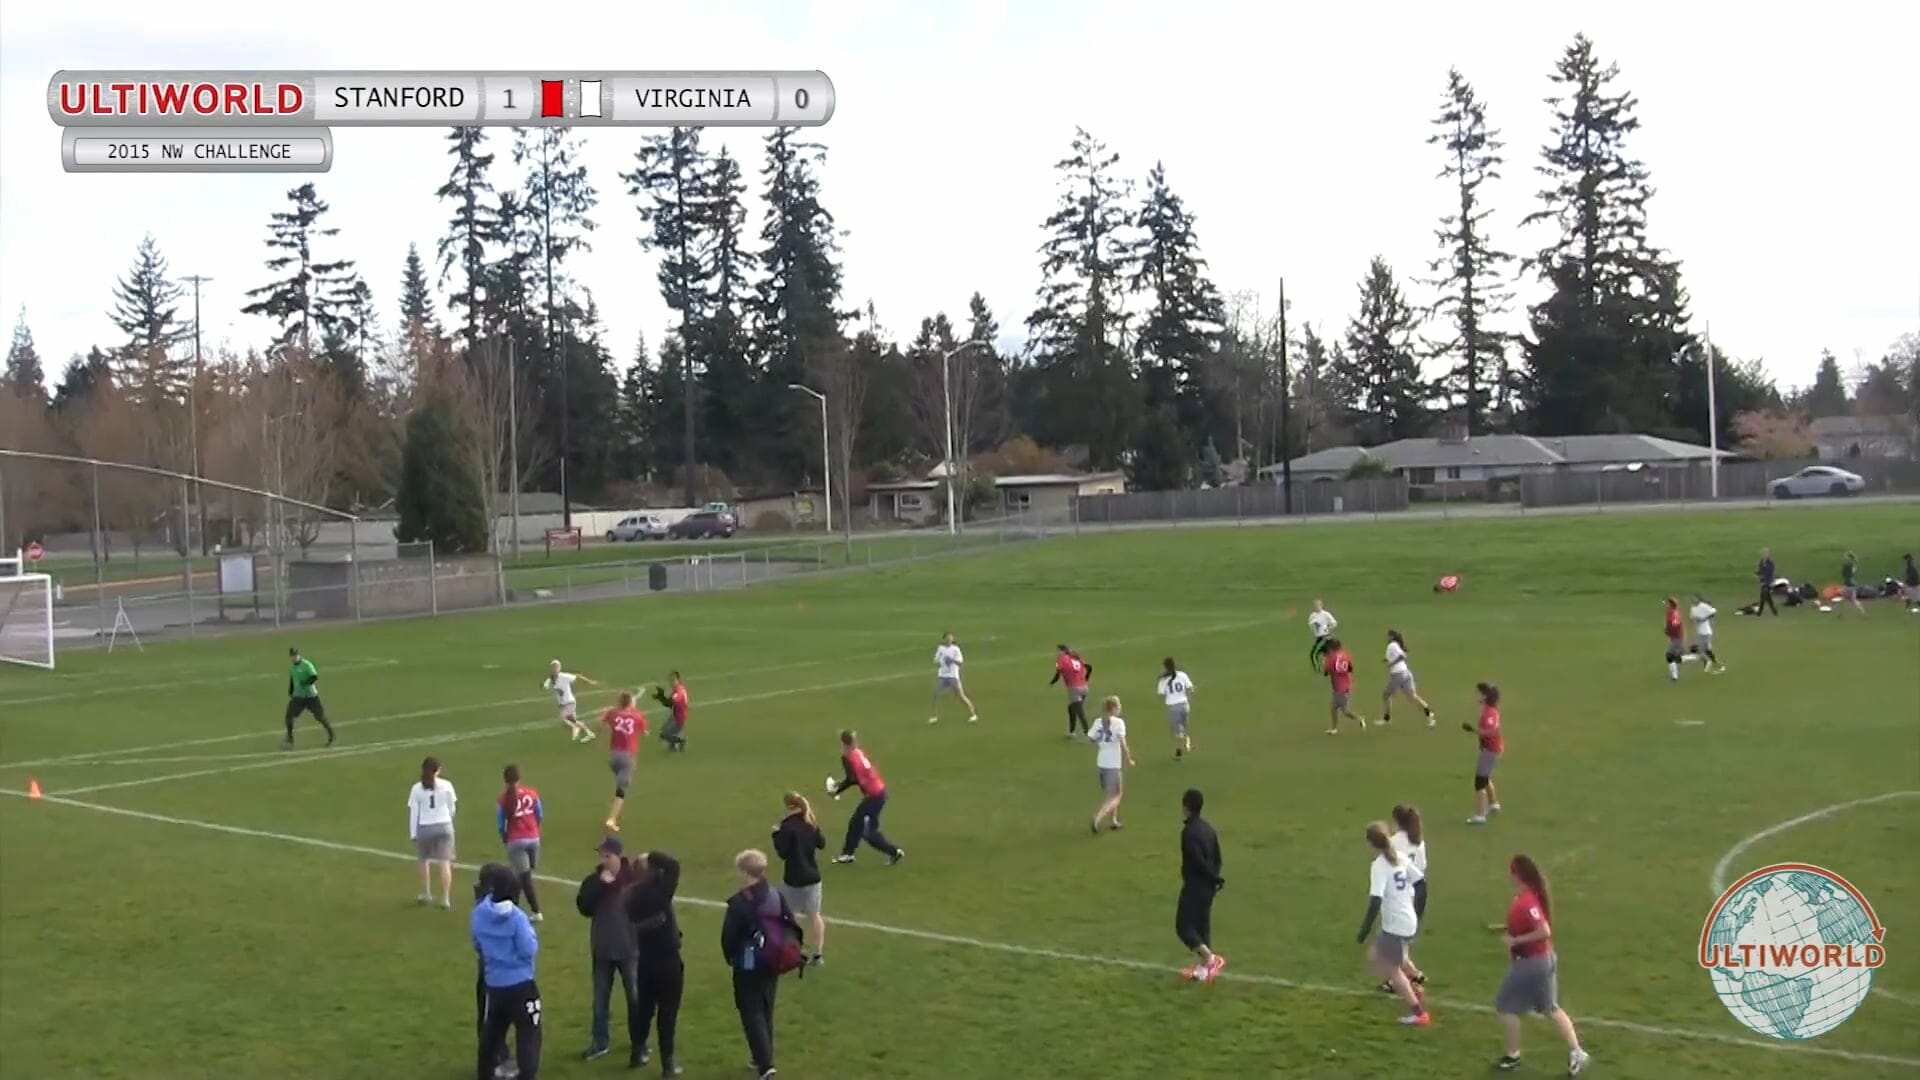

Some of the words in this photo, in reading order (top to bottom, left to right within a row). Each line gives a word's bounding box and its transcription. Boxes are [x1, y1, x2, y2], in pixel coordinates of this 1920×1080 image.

[1168, 681, 1184, 694] 10
[614, 716, 635, 735] 23
[429, 794, 435, 809] 1
[515, 794, 534, 817] 22
[1393, 870, 1406, 891] 5
